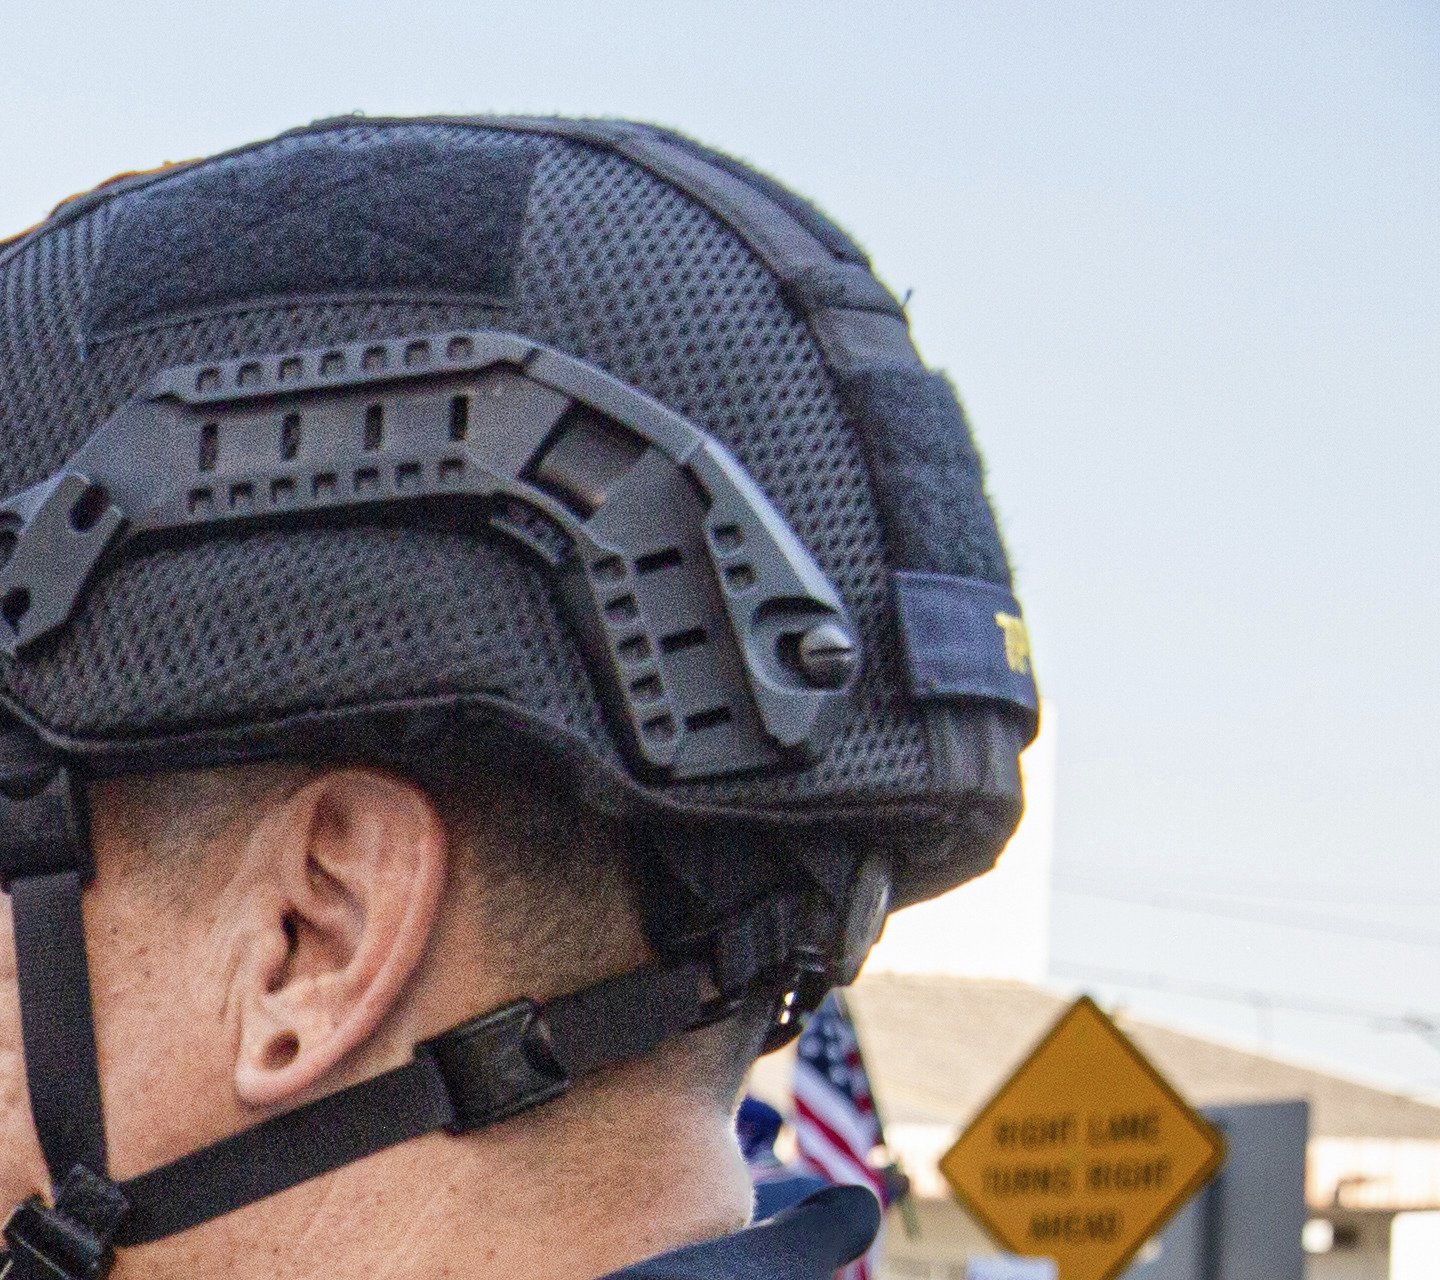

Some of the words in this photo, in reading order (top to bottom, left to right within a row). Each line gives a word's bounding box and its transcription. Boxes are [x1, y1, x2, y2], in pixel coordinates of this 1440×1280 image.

[993, 1112, 1076, 1148] RIGHT
[1086, 1106, 1161, 1147] LANE
[982, 1163, 1072, 1198] TURNS
[1086, 1155, 1171, 1191] RIGHT
[1030, 1207, 1121, 1243] AHEAD
